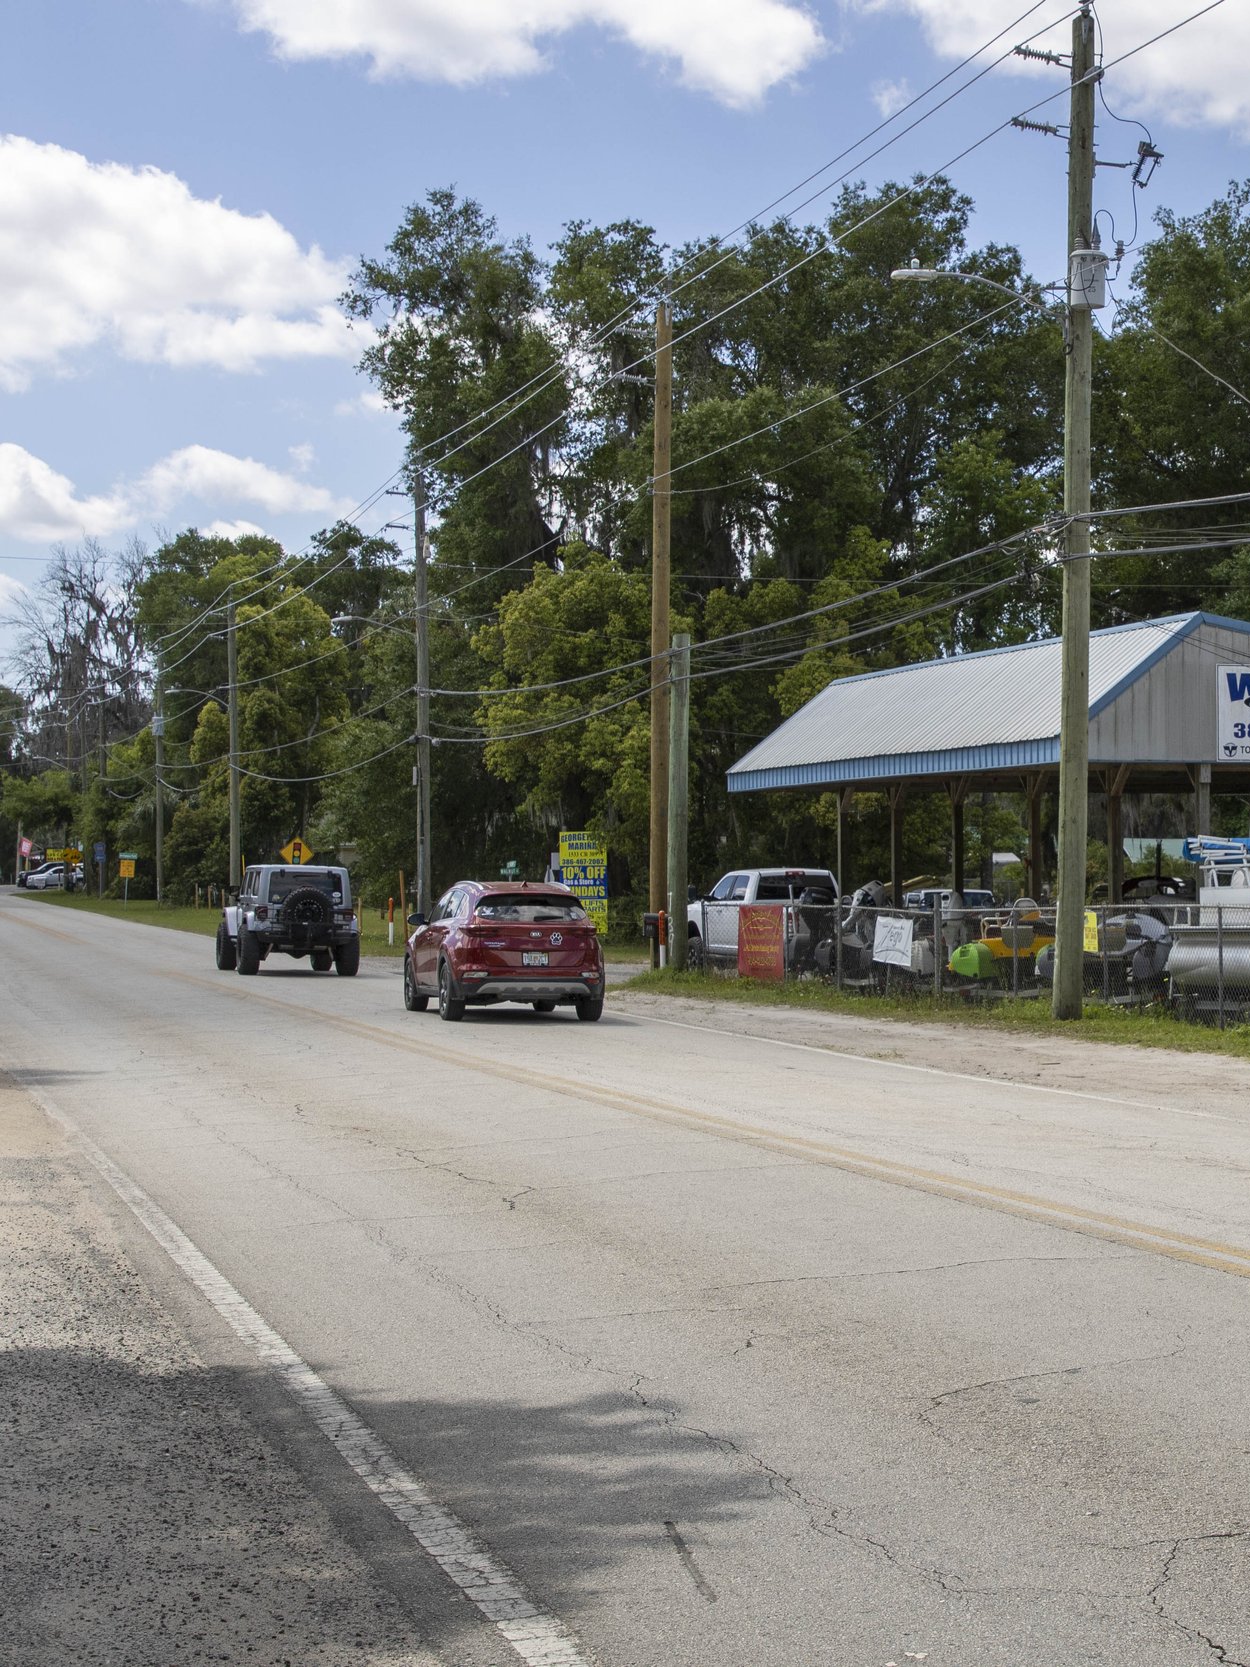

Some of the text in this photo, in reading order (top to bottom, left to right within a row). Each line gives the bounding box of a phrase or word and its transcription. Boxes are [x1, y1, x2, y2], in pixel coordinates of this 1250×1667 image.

[561, 866, 606, 879] 10% OFF
[570, 886, 605, 896] NDAYS
